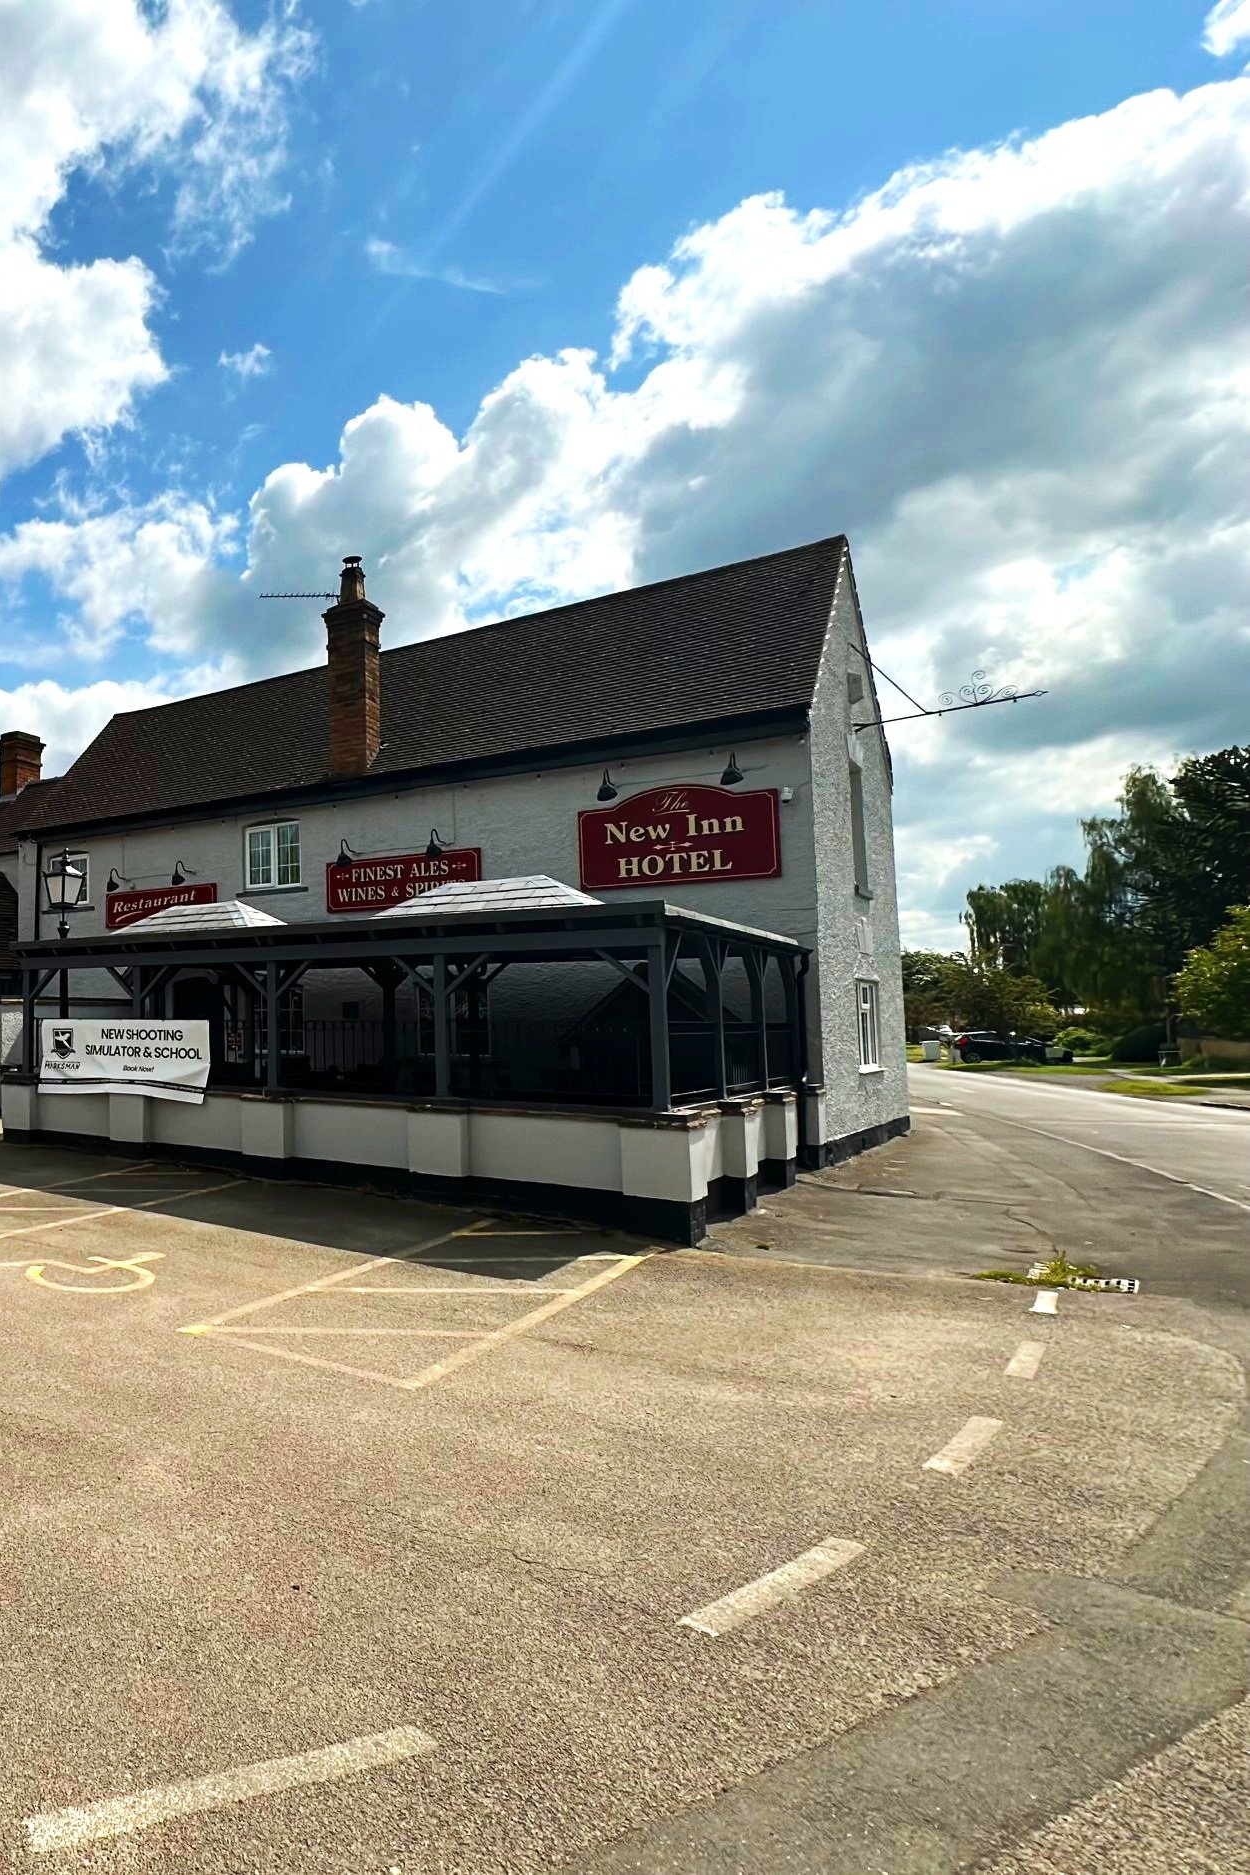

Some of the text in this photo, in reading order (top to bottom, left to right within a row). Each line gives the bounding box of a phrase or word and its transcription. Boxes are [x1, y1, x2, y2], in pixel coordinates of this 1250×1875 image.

[652, 791, 689, 811] The
[604, 813, 745, 845] New Inn
[351, 860, 449, 883] FINEST ALES
[617, 849, 733, 878] HOTEL
[112, 889, 197, 914] Restaurant
[337, 886, 386, 903] WINES
[391, 886, 399, 897] &
[101, 1028, 183, 1041] NEW SHOOTING
[85, 1044, 202, 1060] SIMULATOR & SCHOOL
